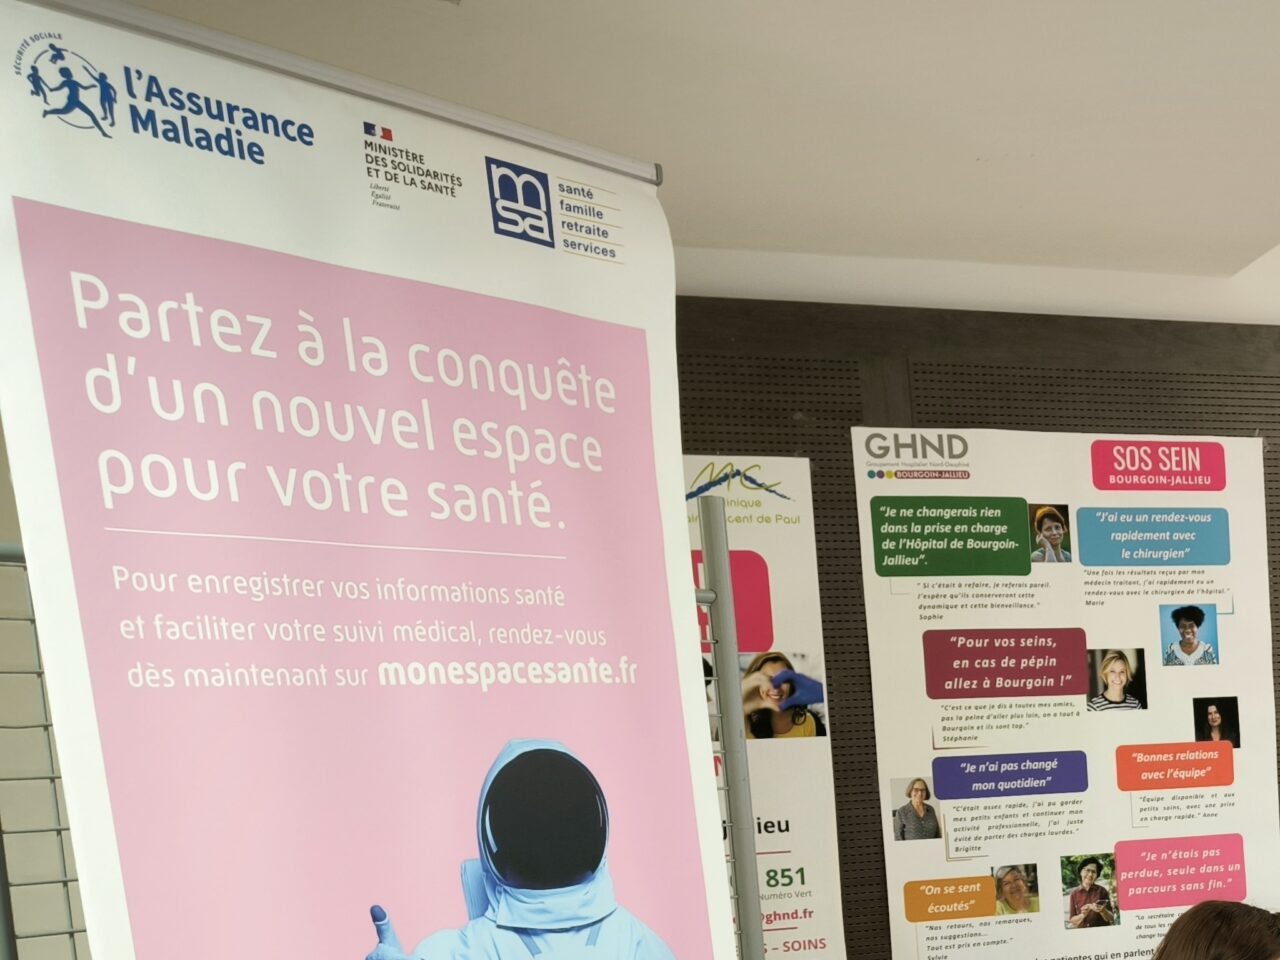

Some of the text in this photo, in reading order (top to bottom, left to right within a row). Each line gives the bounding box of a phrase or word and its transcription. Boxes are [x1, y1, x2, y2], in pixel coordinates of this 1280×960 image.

[29, 32, 62, 43] SOCIALE
[124, 66, 315, 147] l'Assurance
[130, 105, 266, 165] Maladie
[364, 140, 425, 165] MINISTÈRE
[365, 153, 463, 187] DES SOLIDARITÉS
[367, 167, 457, 198] ET DE LA SANTÉ
[558, 182, 594, 200] santé
[559, 200, 604, 220] famille
[561, 220, 609, 239] retraite
[563, 238, 617, 258] services
[69, 270, 617, 415] Partez à la conquête
[85, 352, 604, 475] d'un nouvel espace
[865, 433, 969, 460] GHND
[1113, 446, 1200, 471] SOS SEIN
[896, 471, 970, 479] BOURGOIN-JALLIEU
[1109, 474, 1211, 486] BOURGOIN-JALLIEU
[97, 449, 567, 531] pour votre santé.
[727, 499, 762, 510] inique
[757, 514, 772, 524] de
[775, 514, 801, 525] Paul
[899, 509, 914, 518] ne
[915, 506, 977, 521] changerais
[979, 506, 1001, 518] rien
[1119, 514, 1133, 523] eu
[1135, 514, 1149, 523] un
[1151, 512, 1212, 523] rendez-vous
[880, 522, 1008, 537] dans la prise en charge
[1110, 530, 1196, 543] rapidement avec
[881, 538, 897, 550] de
[950, 538, 965, 549] de
[966, 538, 1019, 552] Bourgoin-
[1121, 548, 1131, 559] le
[112, 565, 567, 607] Pour enregistrer vos informations santé
[919, 613, 944, 621] Sophie
[119, 614, 608, 649] et faciliter votre suivi médical, rendez-vous
[994, 637, 1015, 647] vos
[1019, 636, 1057, 649] seins,
[953, 655, 1057, 671] en cas de pépin
[127, 656, 638, 693] dès maintenant sur monespacesante.fr
[945, 676, 979, 690] allez
[982, 675, 992, 688] à
[995, 675, 1055, 690] Bourgoin
[942, 733, 978, 743] Stéphanie
[1175, 749, 1219, 761] relations
[1001, 762, 1019, 775] pas
[1021, 759, 1058, 775] changé
[1141, 770, 1164, 781] avec
[972, 781, 996, 792] mon
[955, 844, 982, 854] Brigitte
[794, 889, 812, 899] Vert
[783, 938, 828, 953] SOINS
[1110, 951, 1123, 960] en
